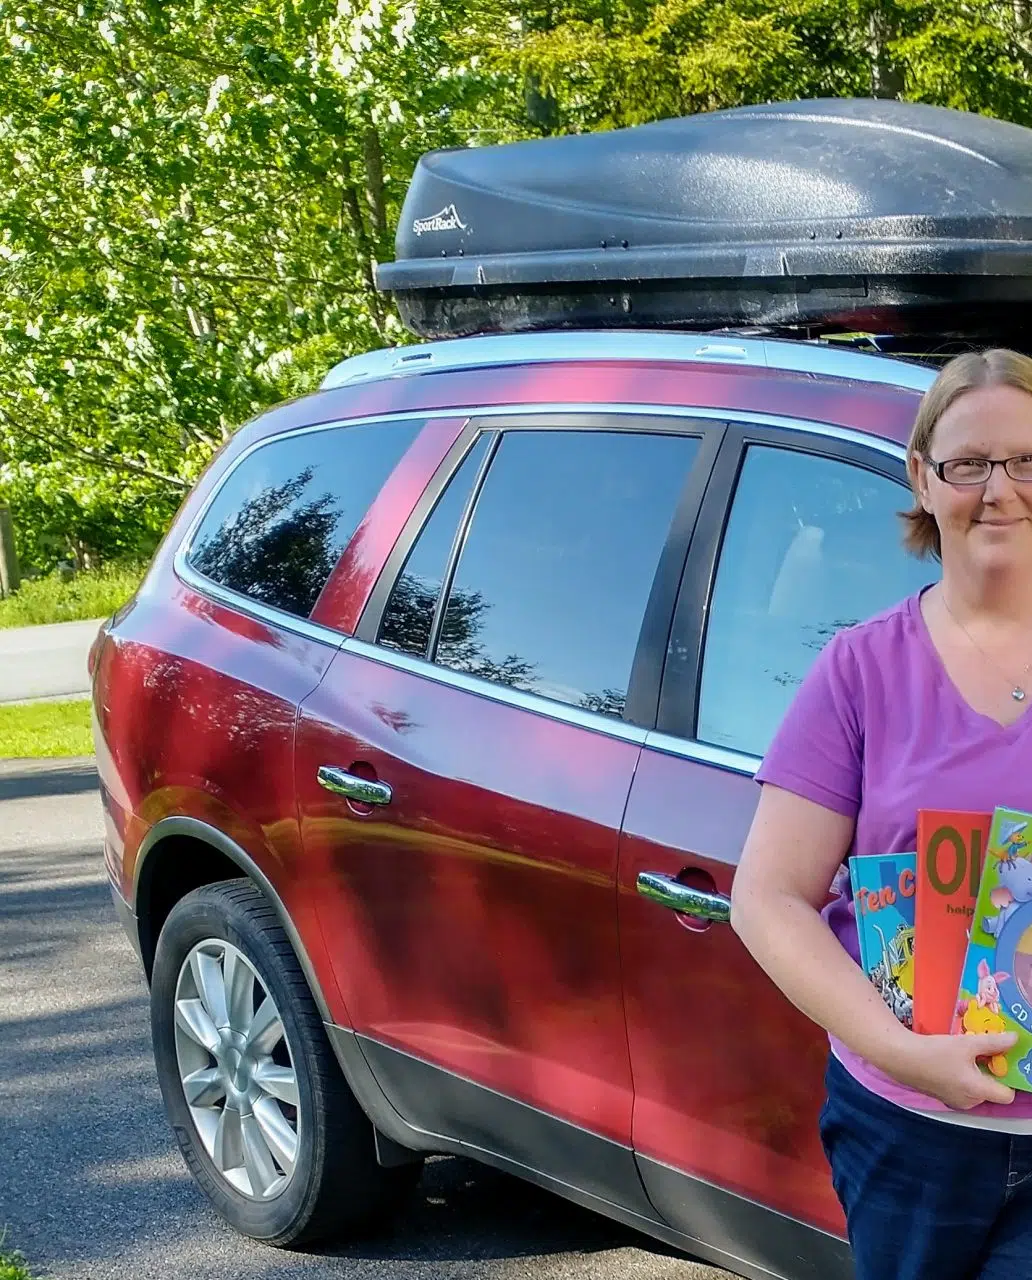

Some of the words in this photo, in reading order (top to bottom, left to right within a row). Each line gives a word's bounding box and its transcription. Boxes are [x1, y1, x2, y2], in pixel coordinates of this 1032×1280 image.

[413, 217, 457, 236] SportRack
[856, 885, 896, 916] Ten
[1011, 1003, 1028, 1021] CD
[1024, 1063, 1031, 1074] 4
